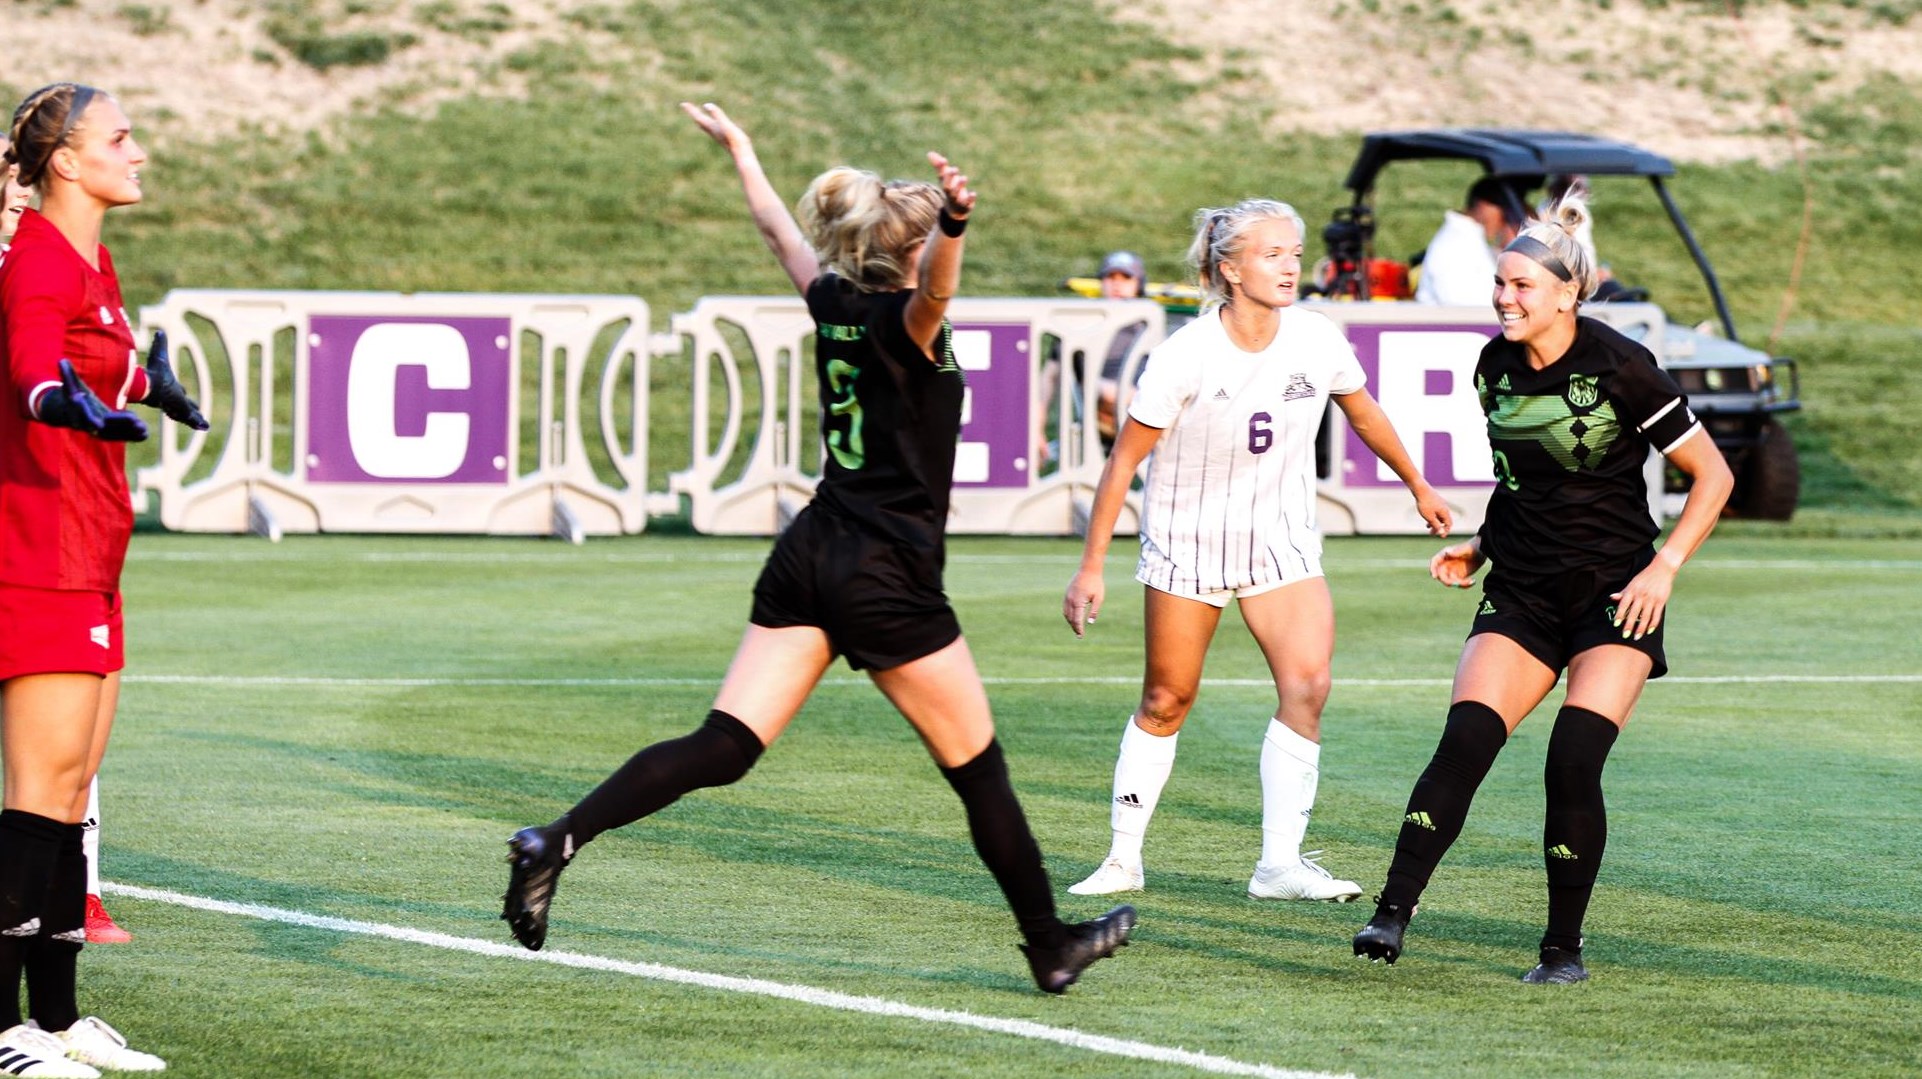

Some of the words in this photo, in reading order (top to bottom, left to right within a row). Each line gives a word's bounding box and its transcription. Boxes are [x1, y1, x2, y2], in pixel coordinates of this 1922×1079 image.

[347, 322, 471, 479] C
[1248, 411, 1273, 455] 6
[1376, 331, 1498, 482] R
